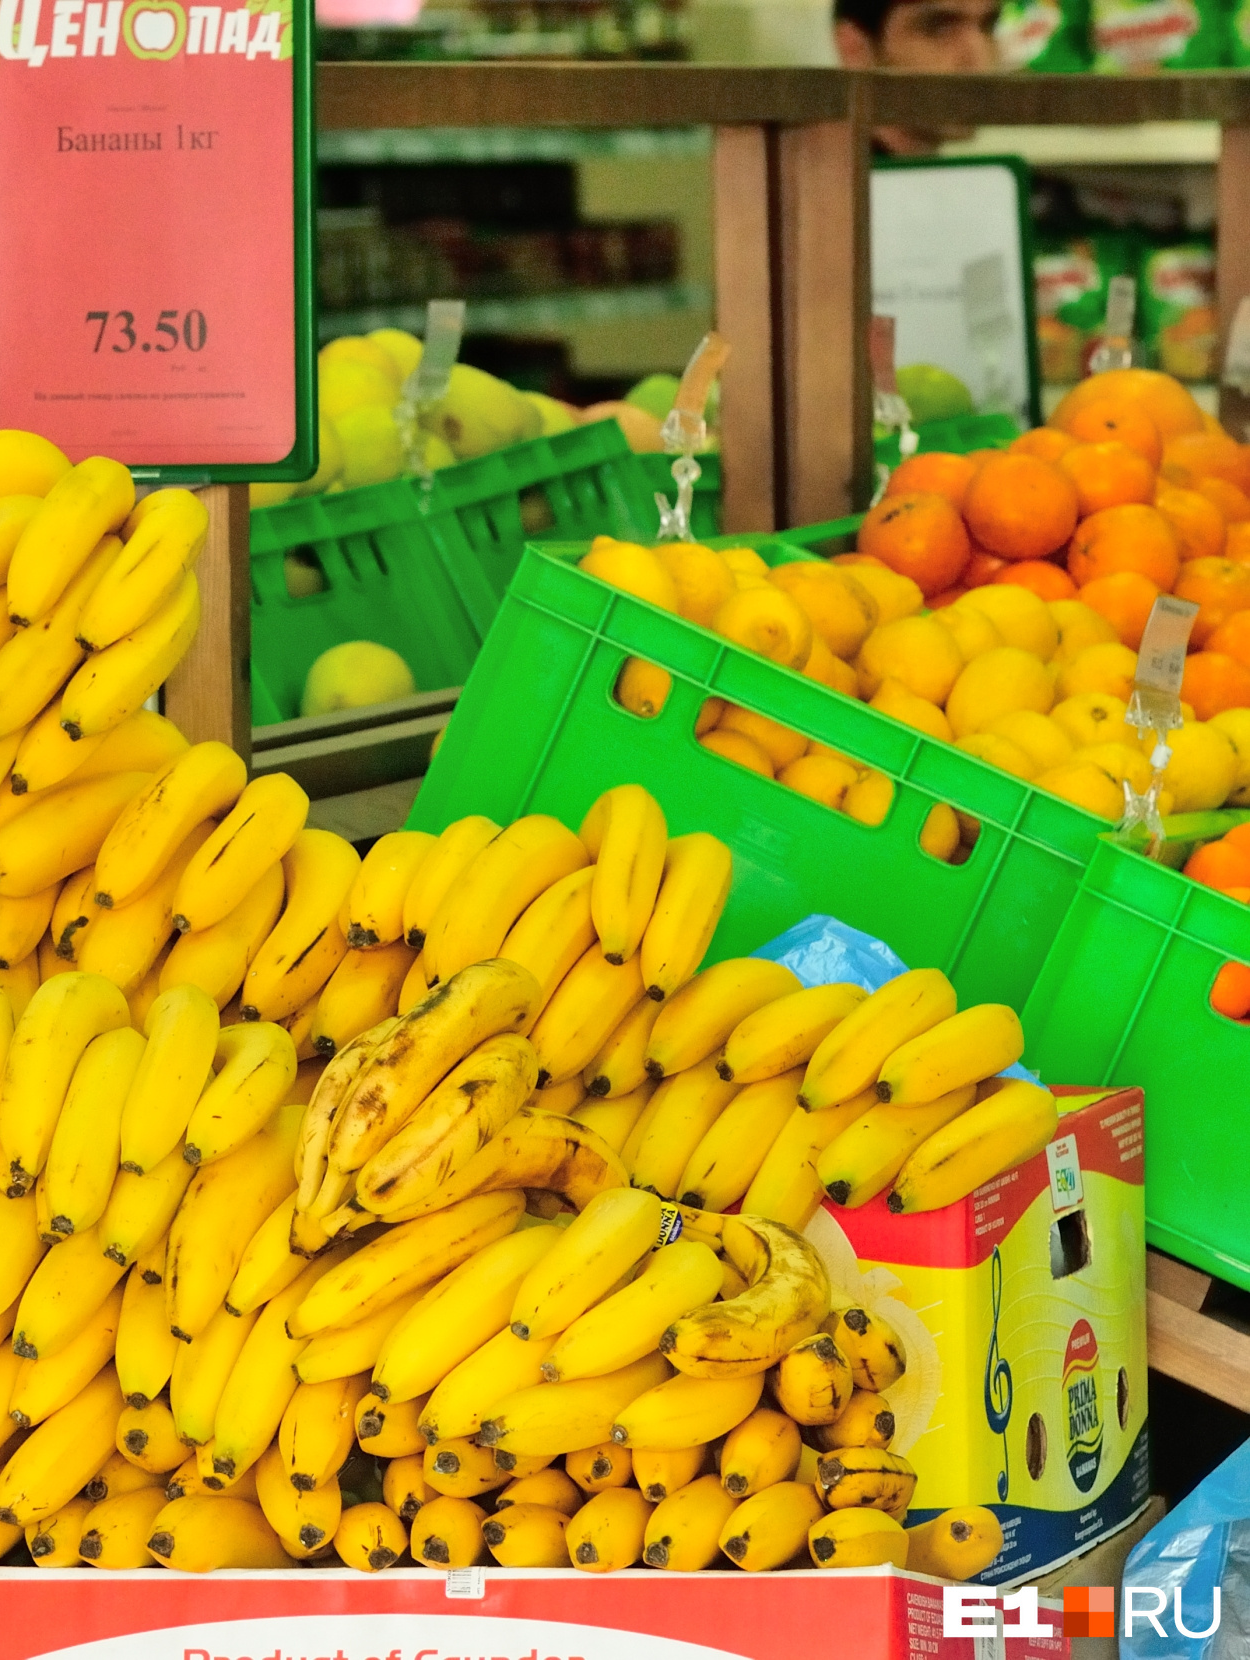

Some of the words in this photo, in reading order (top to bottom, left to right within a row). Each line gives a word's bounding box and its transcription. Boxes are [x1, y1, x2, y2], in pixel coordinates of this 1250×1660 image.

[56, 126, 162, 152] Бананы
[85, 309, 208, 352] 73.50
[1068, 1374, 1098, 1414] PRIMA
[1069, 1402, 1099, 1441] DONNA
